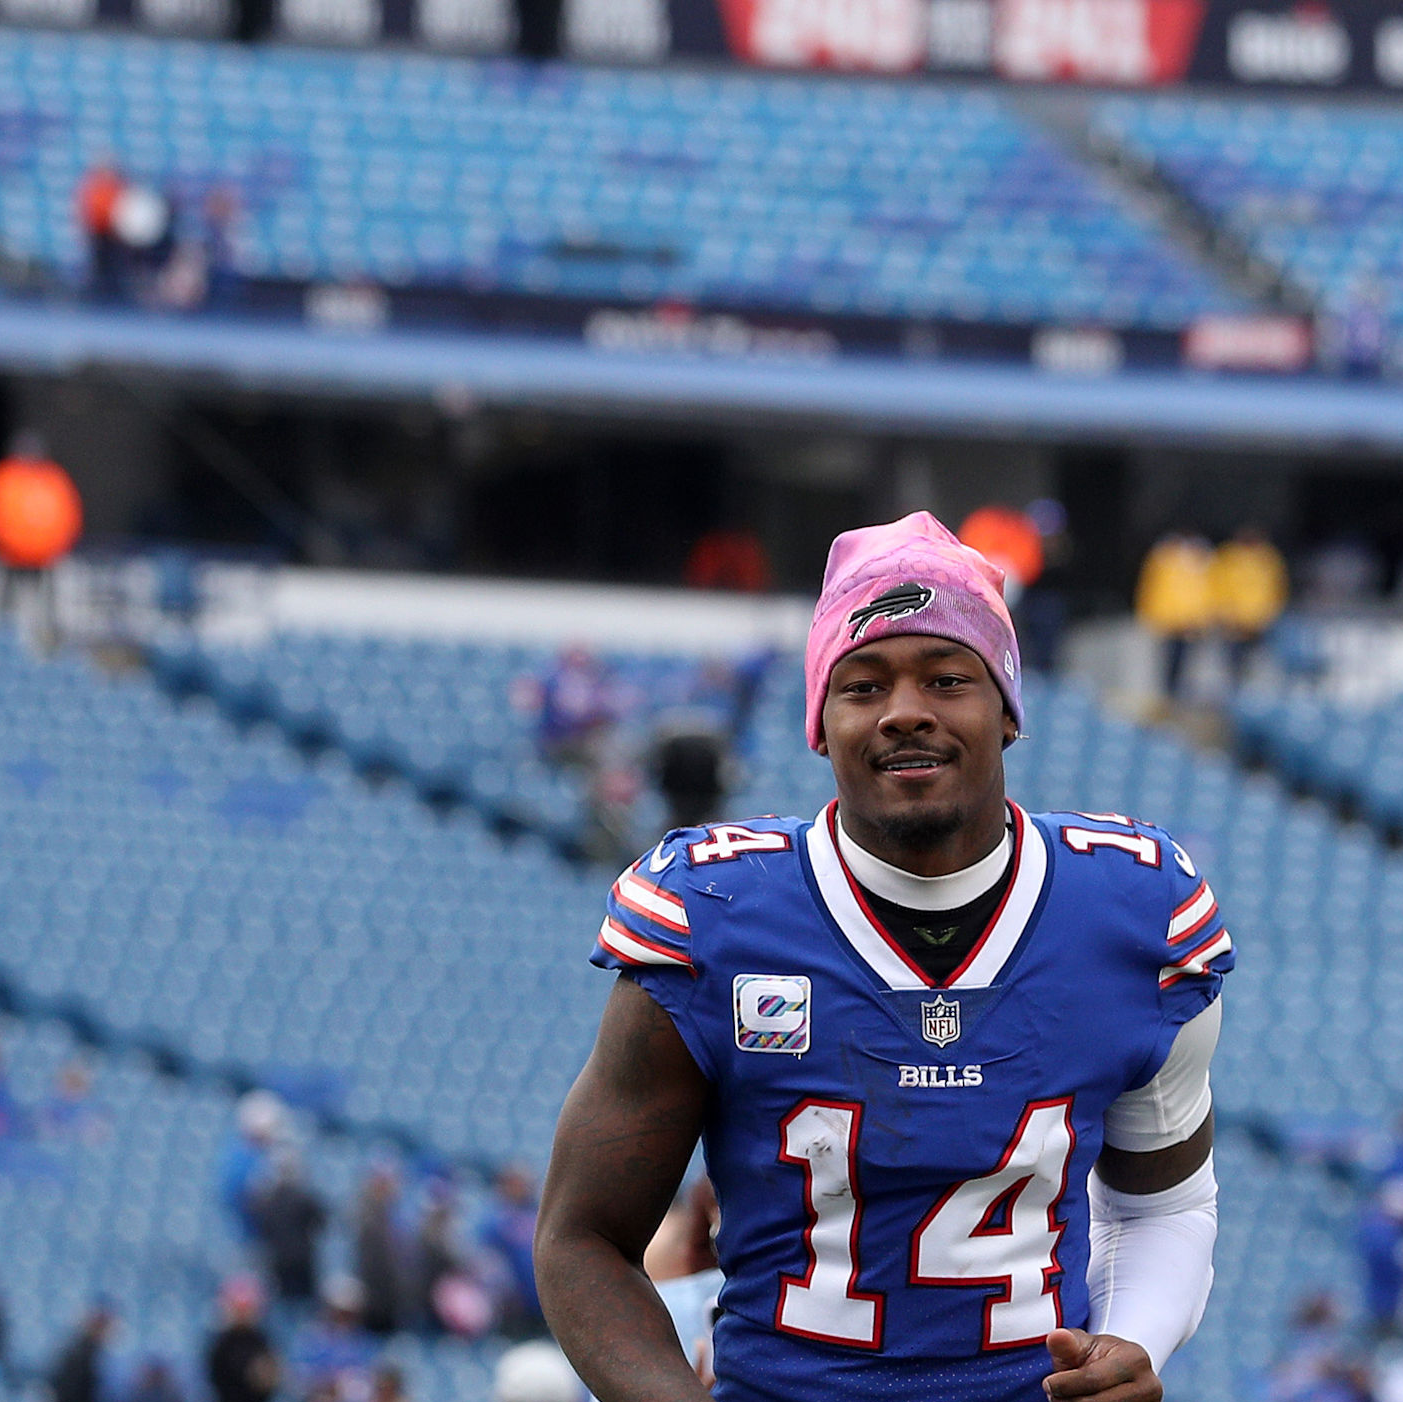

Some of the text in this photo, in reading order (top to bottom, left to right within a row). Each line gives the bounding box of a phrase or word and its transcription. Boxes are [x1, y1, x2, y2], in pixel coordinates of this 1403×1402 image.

[927, 1017, 955, 1036] NFL
[898, 1064, 984, 1088] BILLS
[775, 1096, 1076, 1352] 14
